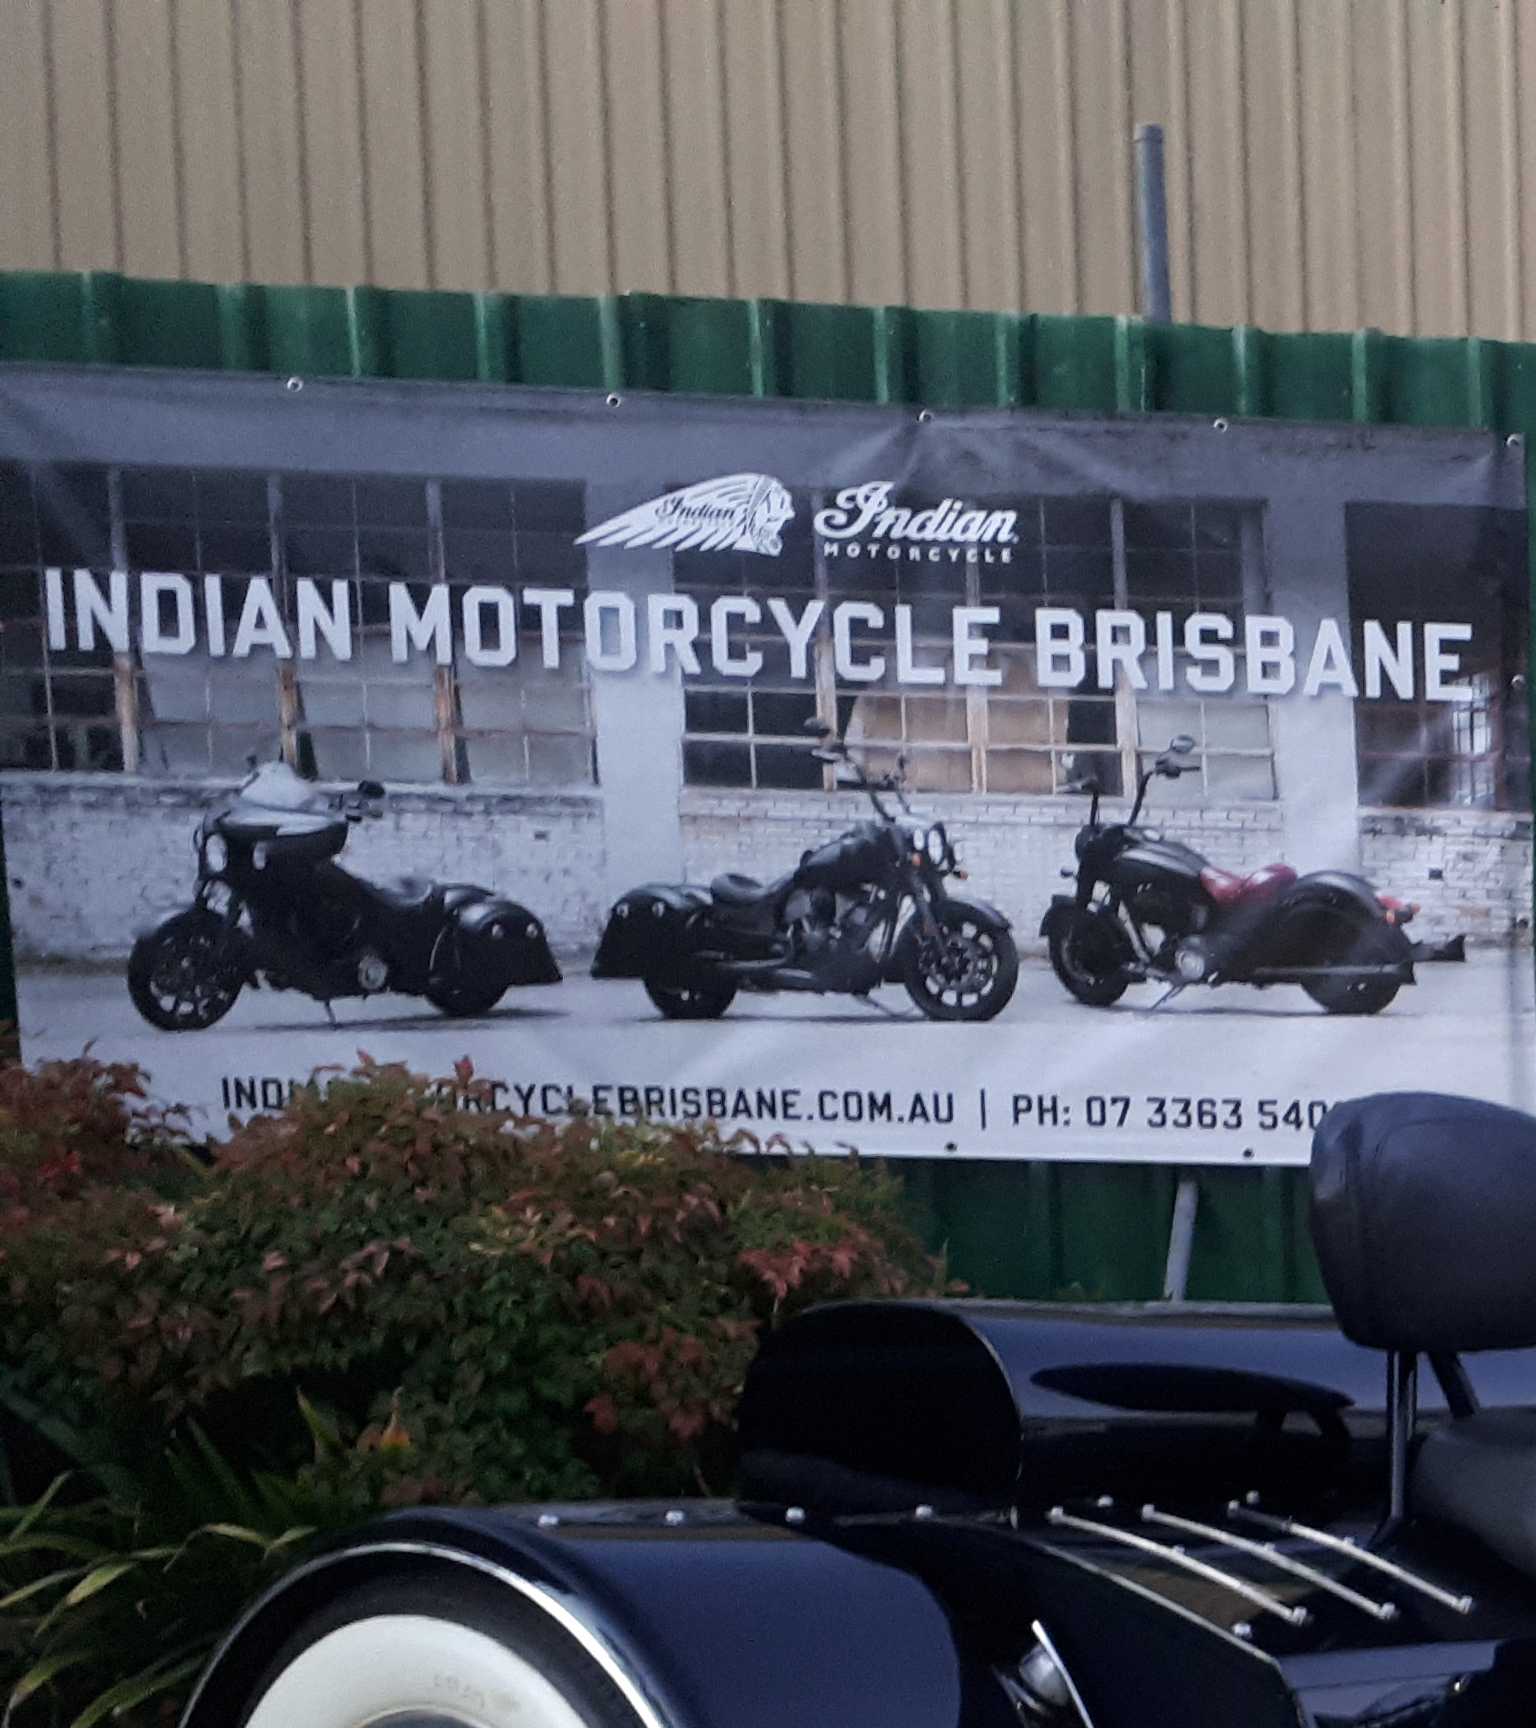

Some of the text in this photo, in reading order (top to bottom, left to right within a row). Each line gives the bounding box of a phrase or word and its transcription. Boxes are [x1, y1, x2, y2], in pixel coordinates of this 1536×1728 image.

[814, 480, 1017, 544] Indian
[824, 541, 1013, 564] MOTORCYCLE
[44, 568, 1474, 703] INDIAN MOTORCYCLE BRISBANE
[1012, 1093, 1071, 1128] PH:
[1086, 1096, 1131, 1128] 07
[1147, 1098, 1243, 1130] 3363
